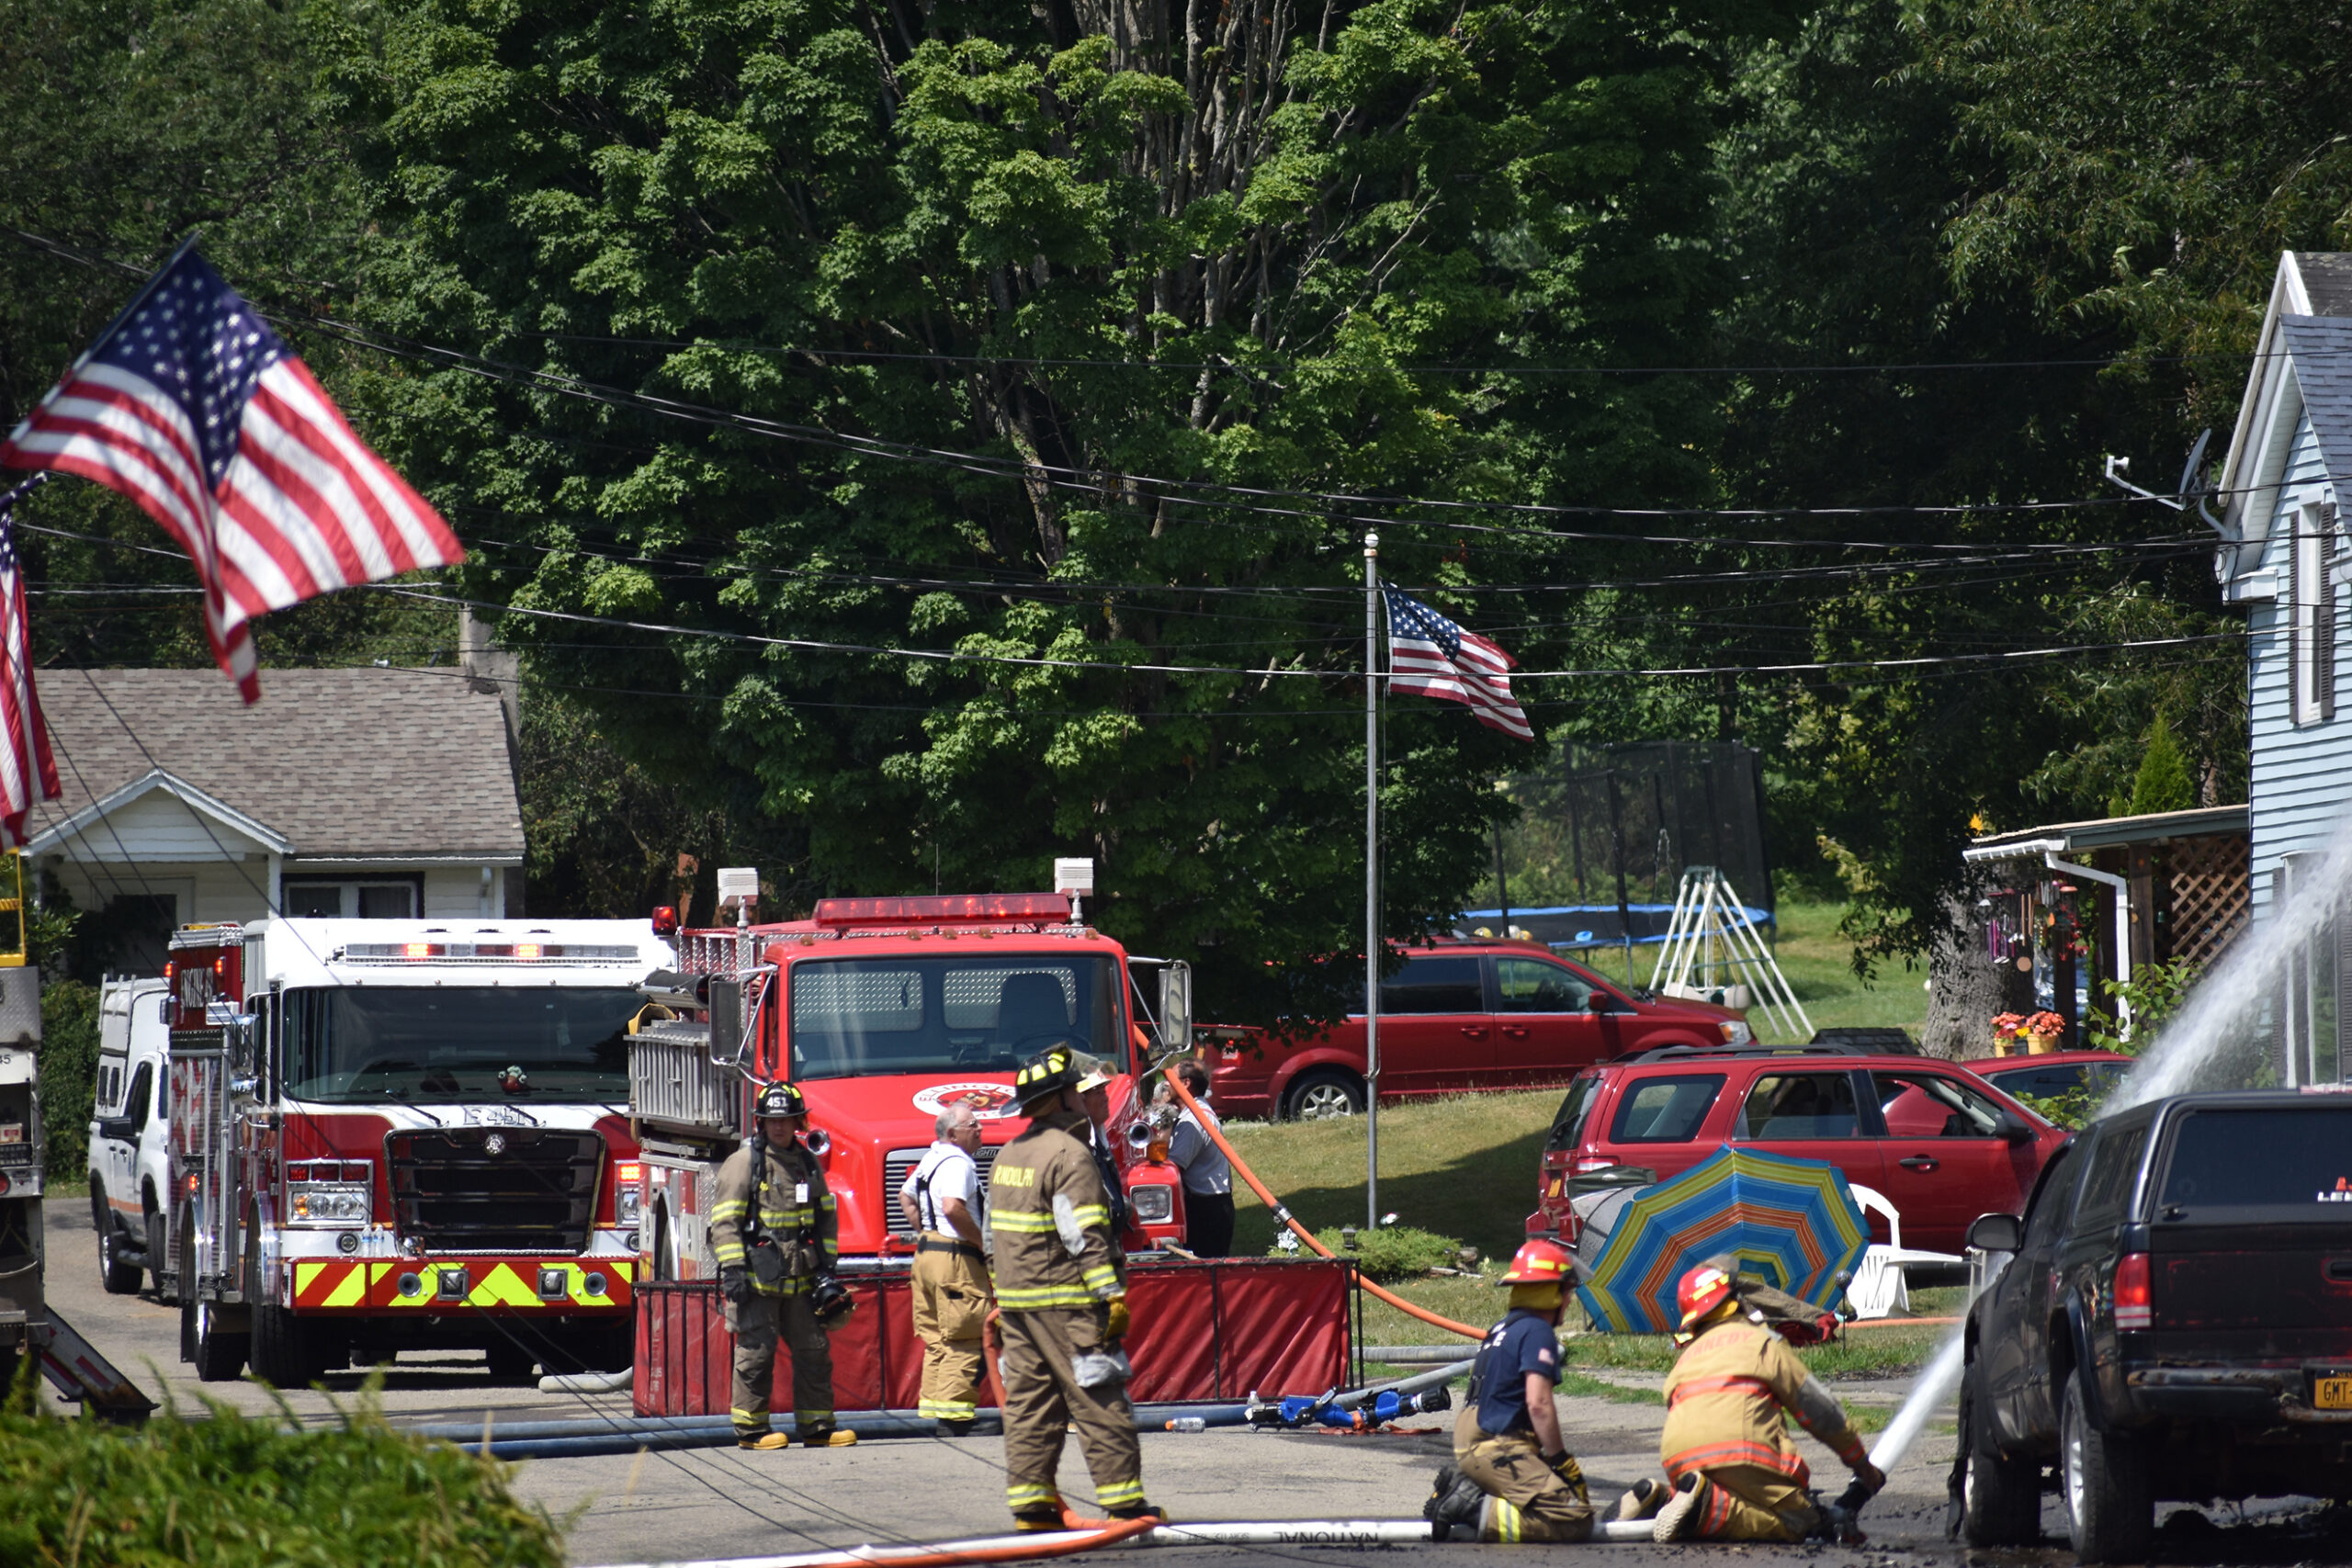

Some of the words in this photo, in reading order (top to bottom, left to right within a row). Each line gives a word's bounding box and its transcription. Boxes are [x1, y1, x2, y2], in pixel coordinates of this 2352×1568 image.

[0, 1054, 11, 1065] 5
[765, 1096, 788, 1108] 451
[463, 1107, 482, 1125] E
